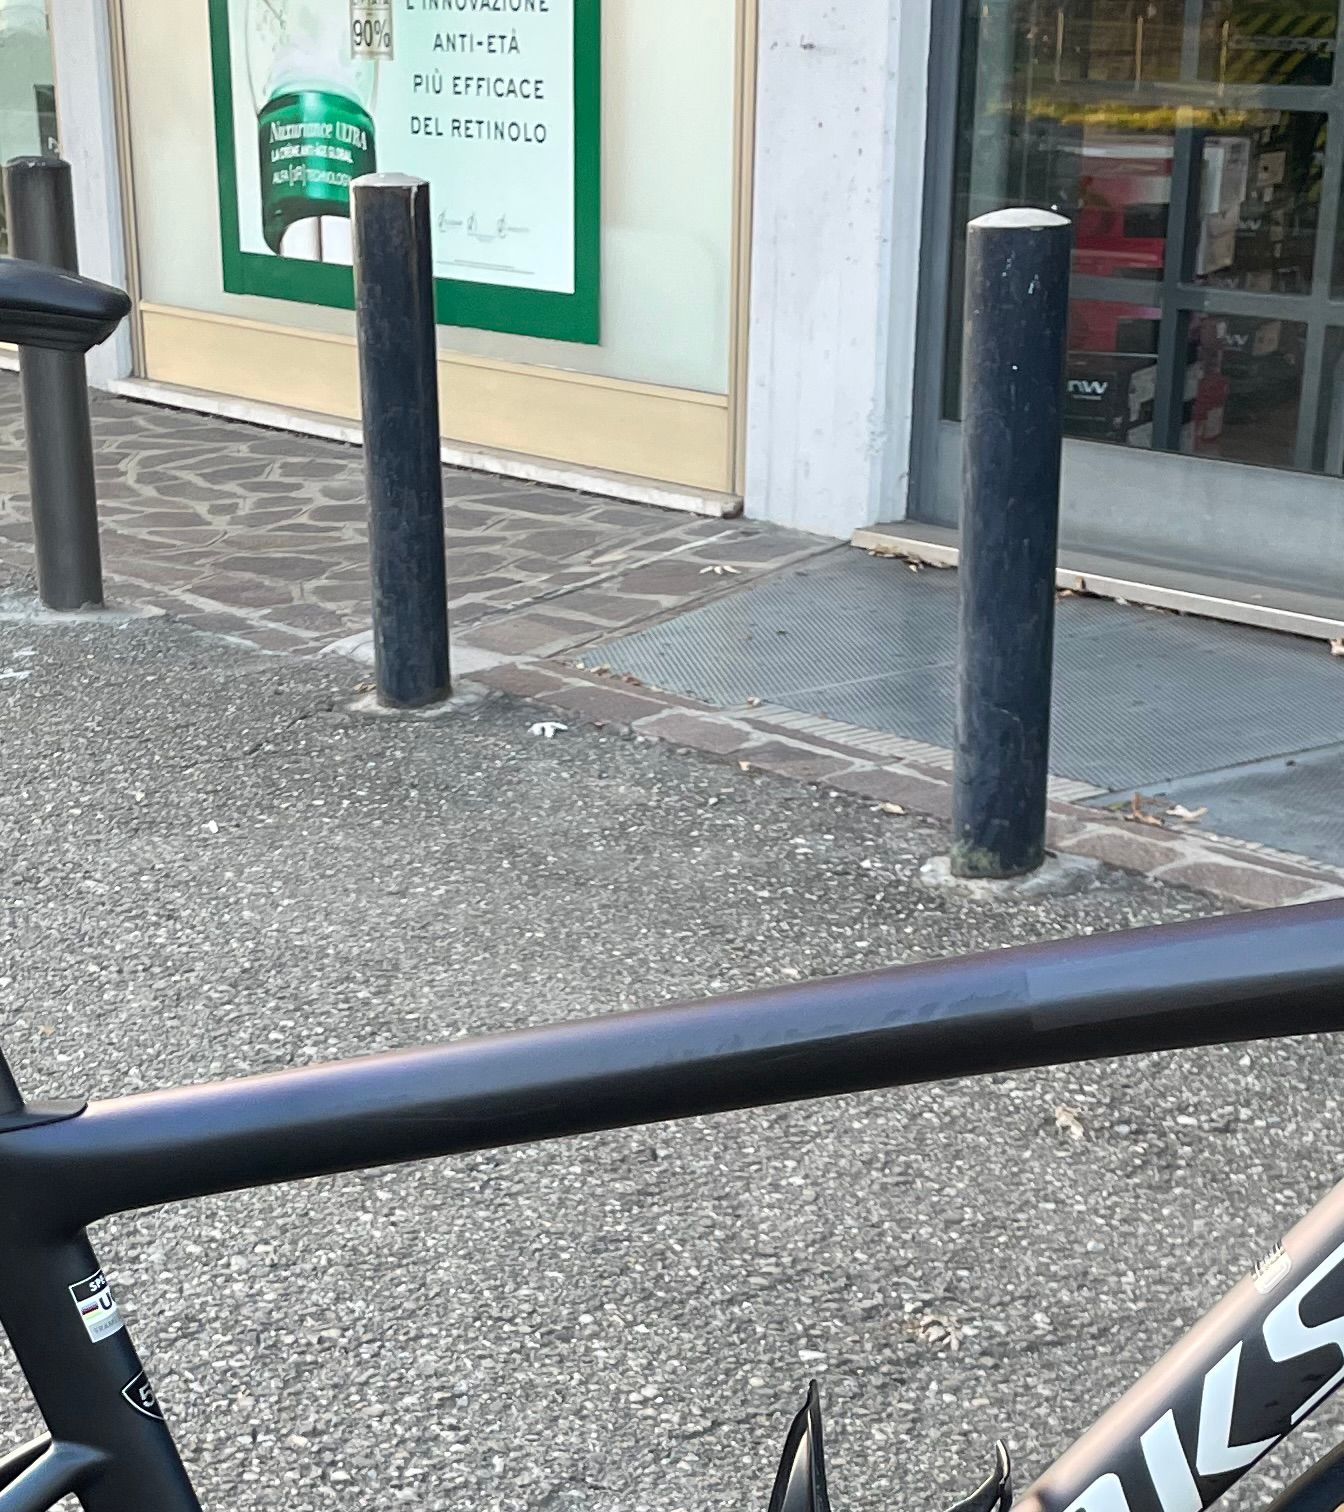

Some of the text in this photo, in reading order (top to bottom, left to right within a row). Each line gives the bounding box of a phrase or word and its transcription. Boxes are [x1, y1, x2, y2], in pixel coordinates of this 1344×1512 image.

[406, 0, 549, 12] LINNOVAZIONE
[353, 19, 391, 48] 90%
[433, 28, 520, 54] ANTI-ETÀ
[413, 68, 545, 100] PIÙ EFFICACE
[410, 116, 547, 143] DEL RETINOLO
[99, 1290, 116, 1310] U
